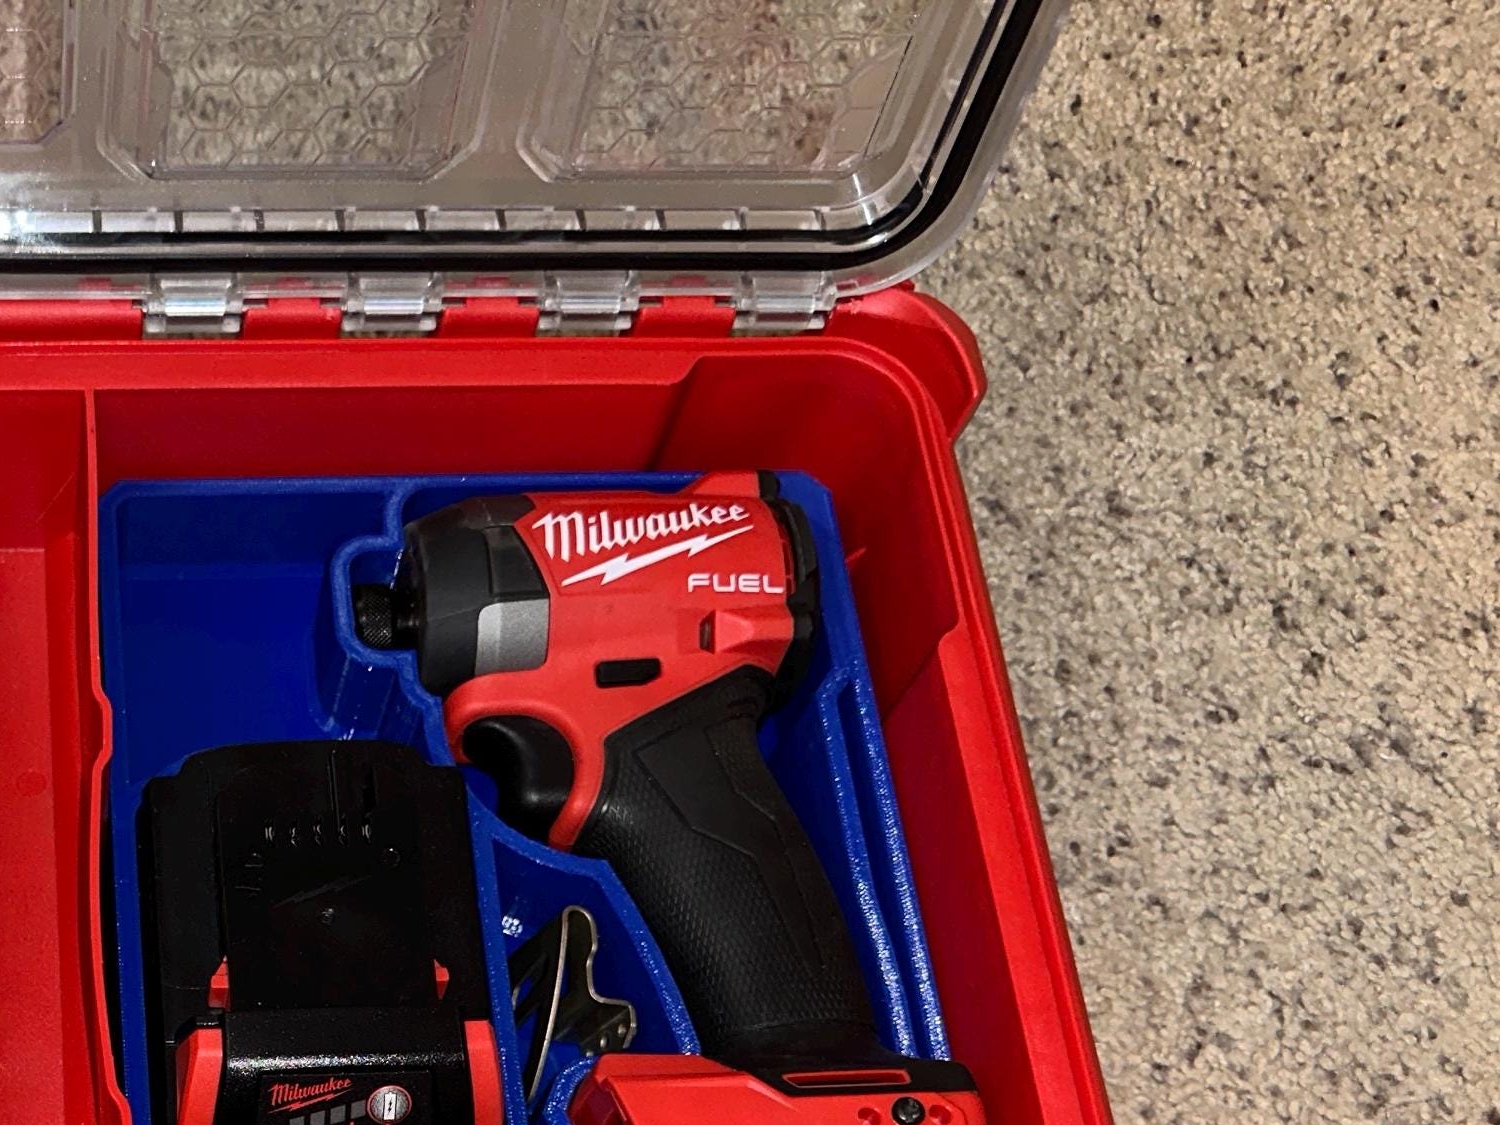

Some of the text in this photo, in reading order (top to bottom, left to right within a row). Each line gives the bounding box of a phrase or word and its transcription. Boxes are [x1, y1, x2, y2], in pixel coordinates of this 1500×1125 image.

[532, 502, 751, 563] Milwaukee
[687, 573, 786, 594] FUEL
[268, 1077, 353, 1106] Milwaukee
